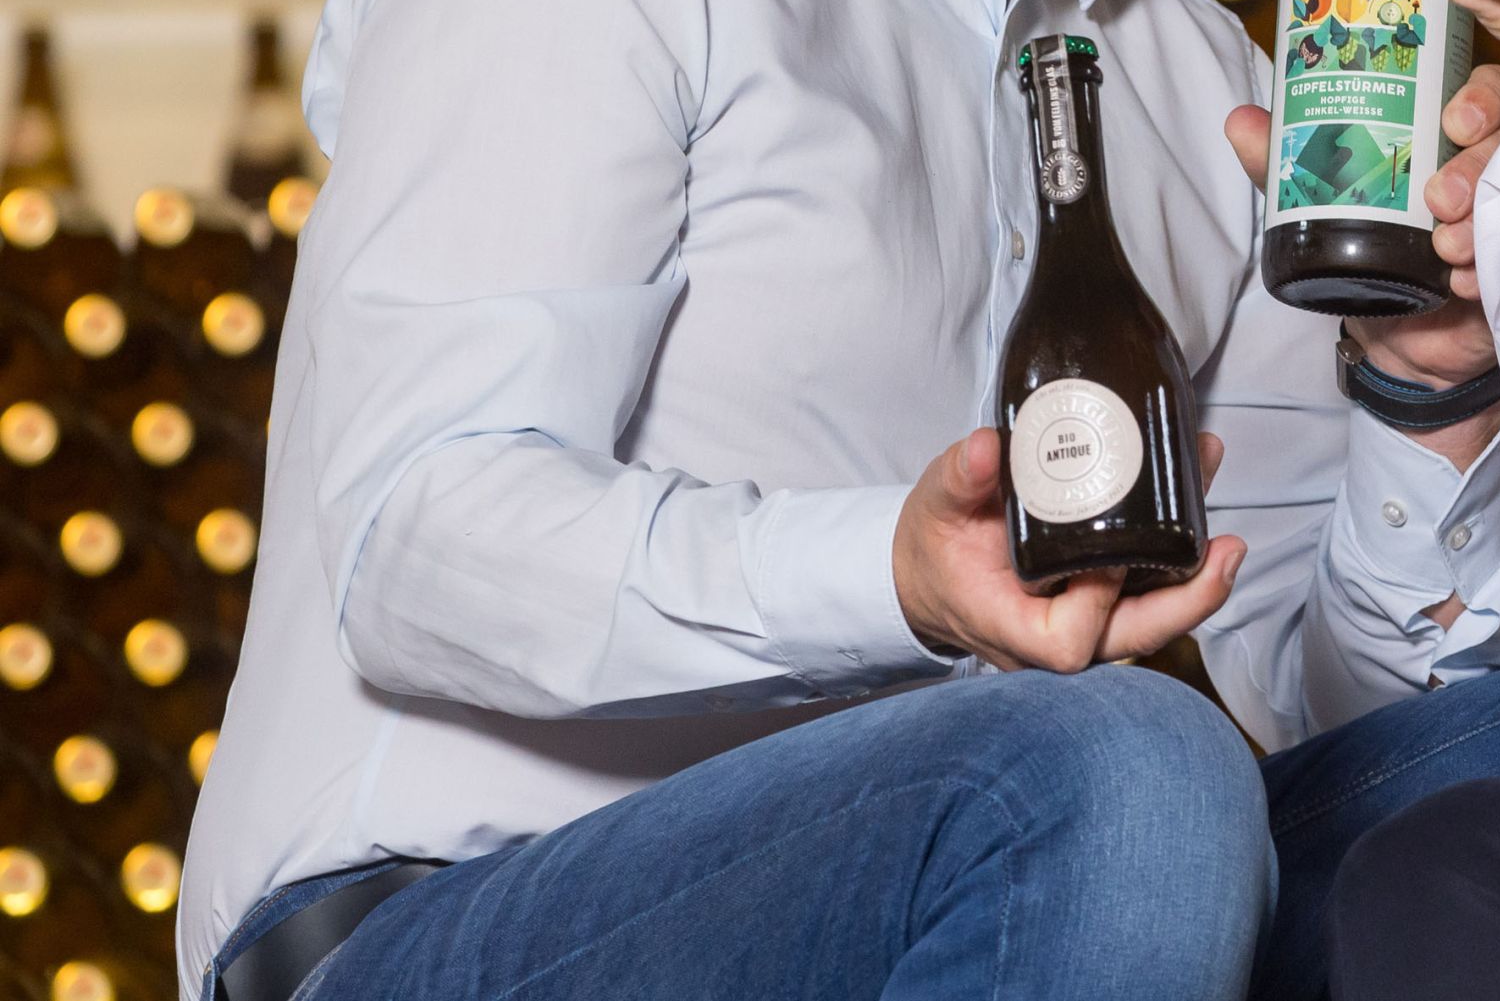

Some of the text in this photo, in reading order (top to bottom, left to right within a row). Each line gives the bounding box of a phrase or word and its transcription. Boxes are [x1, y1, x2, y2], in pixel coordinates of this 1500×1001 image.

[1291, 79, 1406, 97] GIPFELSTÜRMER
[1320, 96, 1366, 105] HOPFIGE
[1304, 106, 1384, 117] DINKEL-WEISSE
[1058, 432, 1076, 444] BIO
[1046, 444, 1091, 462] ANTIQUE
